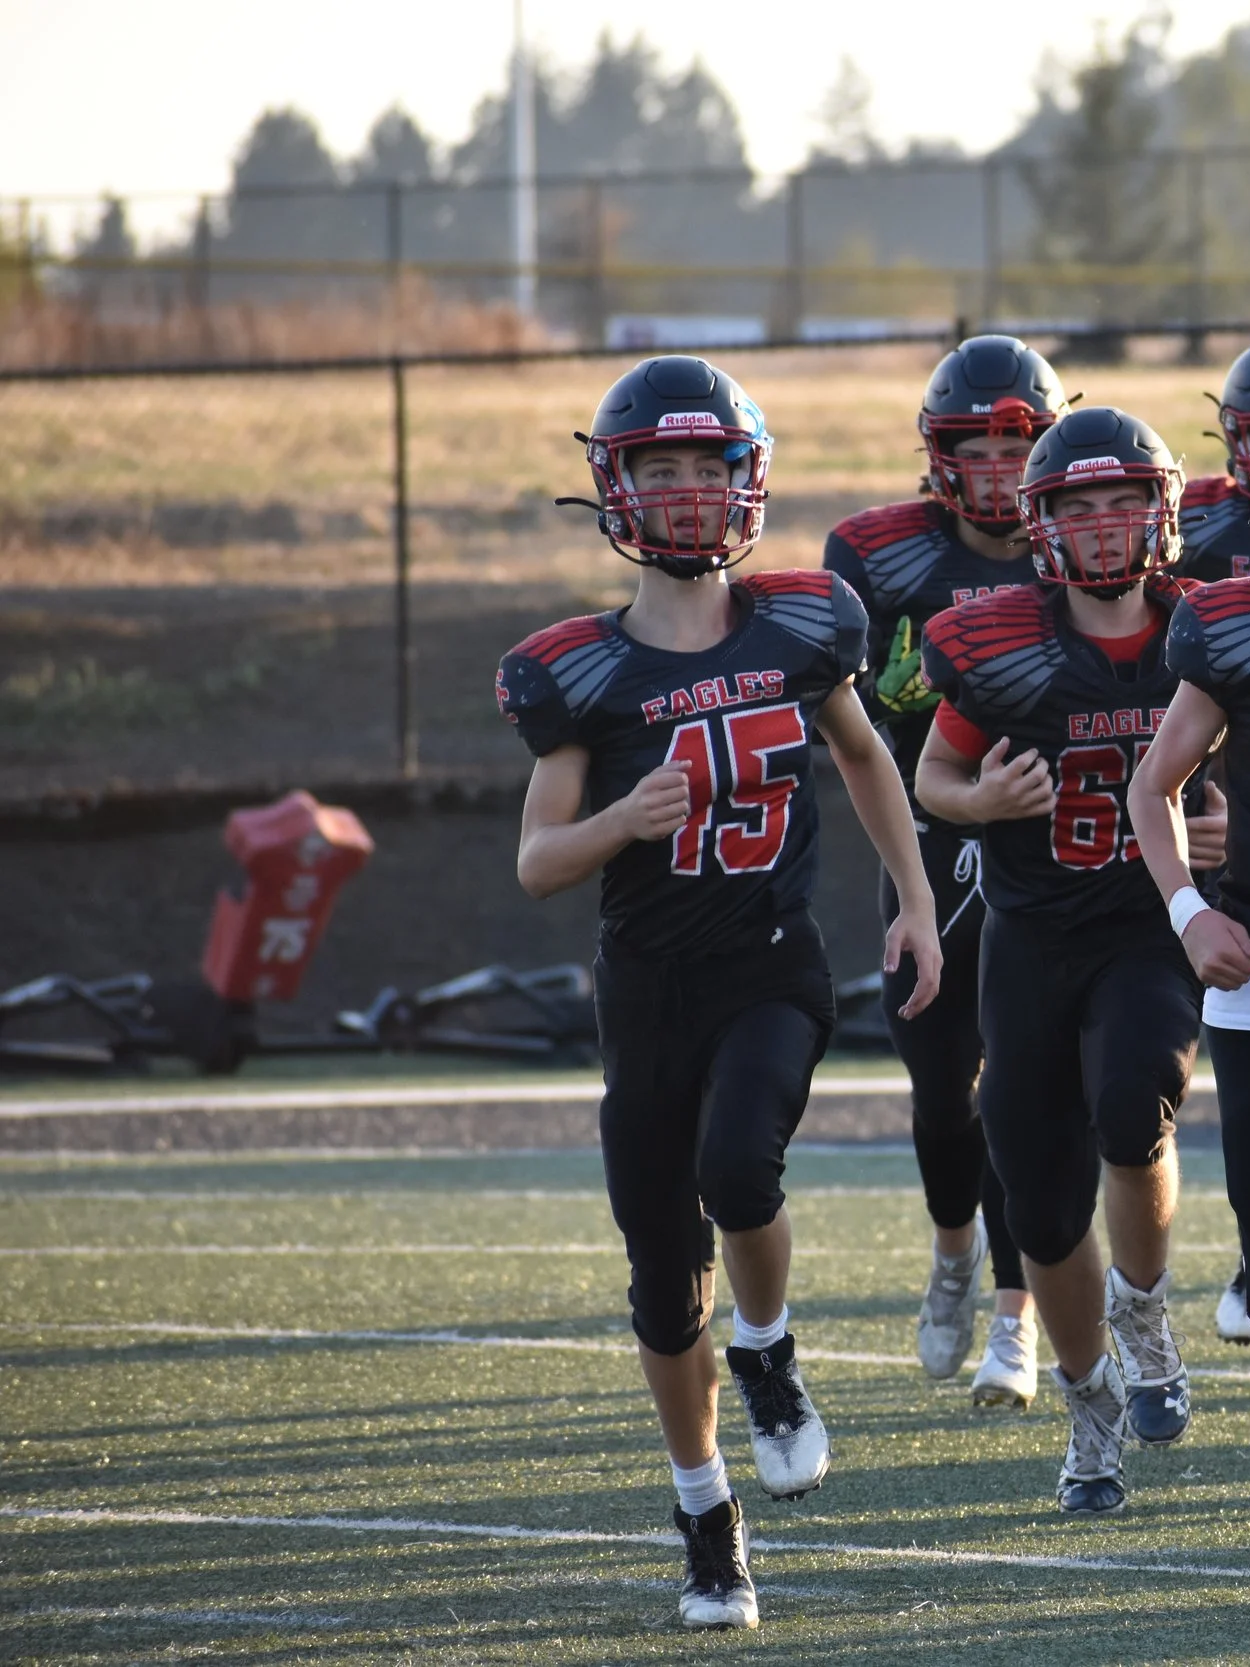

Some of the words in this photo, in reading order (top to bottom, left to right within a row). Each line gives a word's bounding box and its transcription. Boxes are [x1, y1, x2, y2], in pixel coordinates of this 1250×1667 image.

[664, 414, 713, 426] Riddell
[1072, 458, 1115, 472] Riddell
[641, 670, 784, 726] EAGLES
[1068, 708, 1169, 740] EAGLE
[662, 702, 806, 876] 15
[1050, 741, 1151, 871] 6
